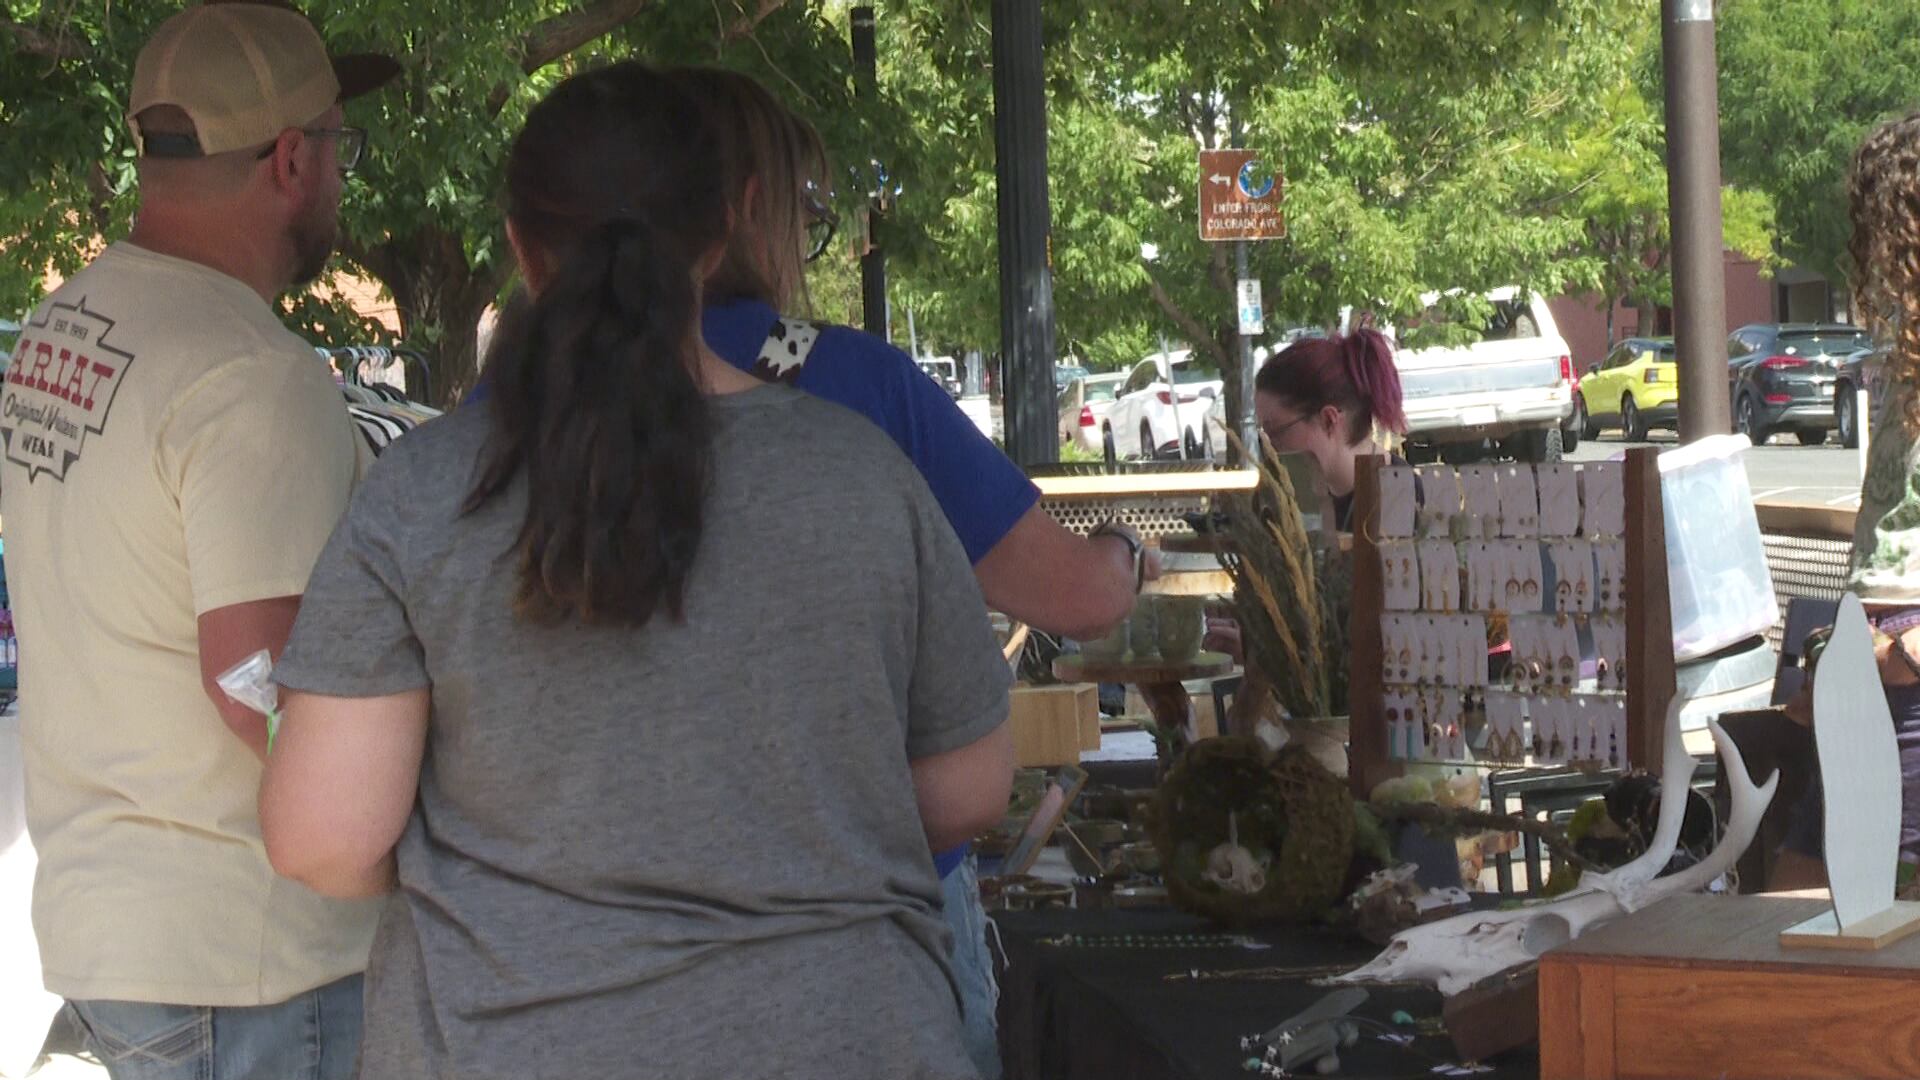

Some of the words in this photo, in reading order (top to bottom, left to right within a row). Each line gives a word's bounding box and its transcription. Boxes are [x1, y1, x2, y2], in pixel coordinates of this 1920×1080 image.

[1207, 217, 1257, 230] COLORADO
[5, 338, 115, 412] ARIAT
[21, 432, 55, 458] WEAR
